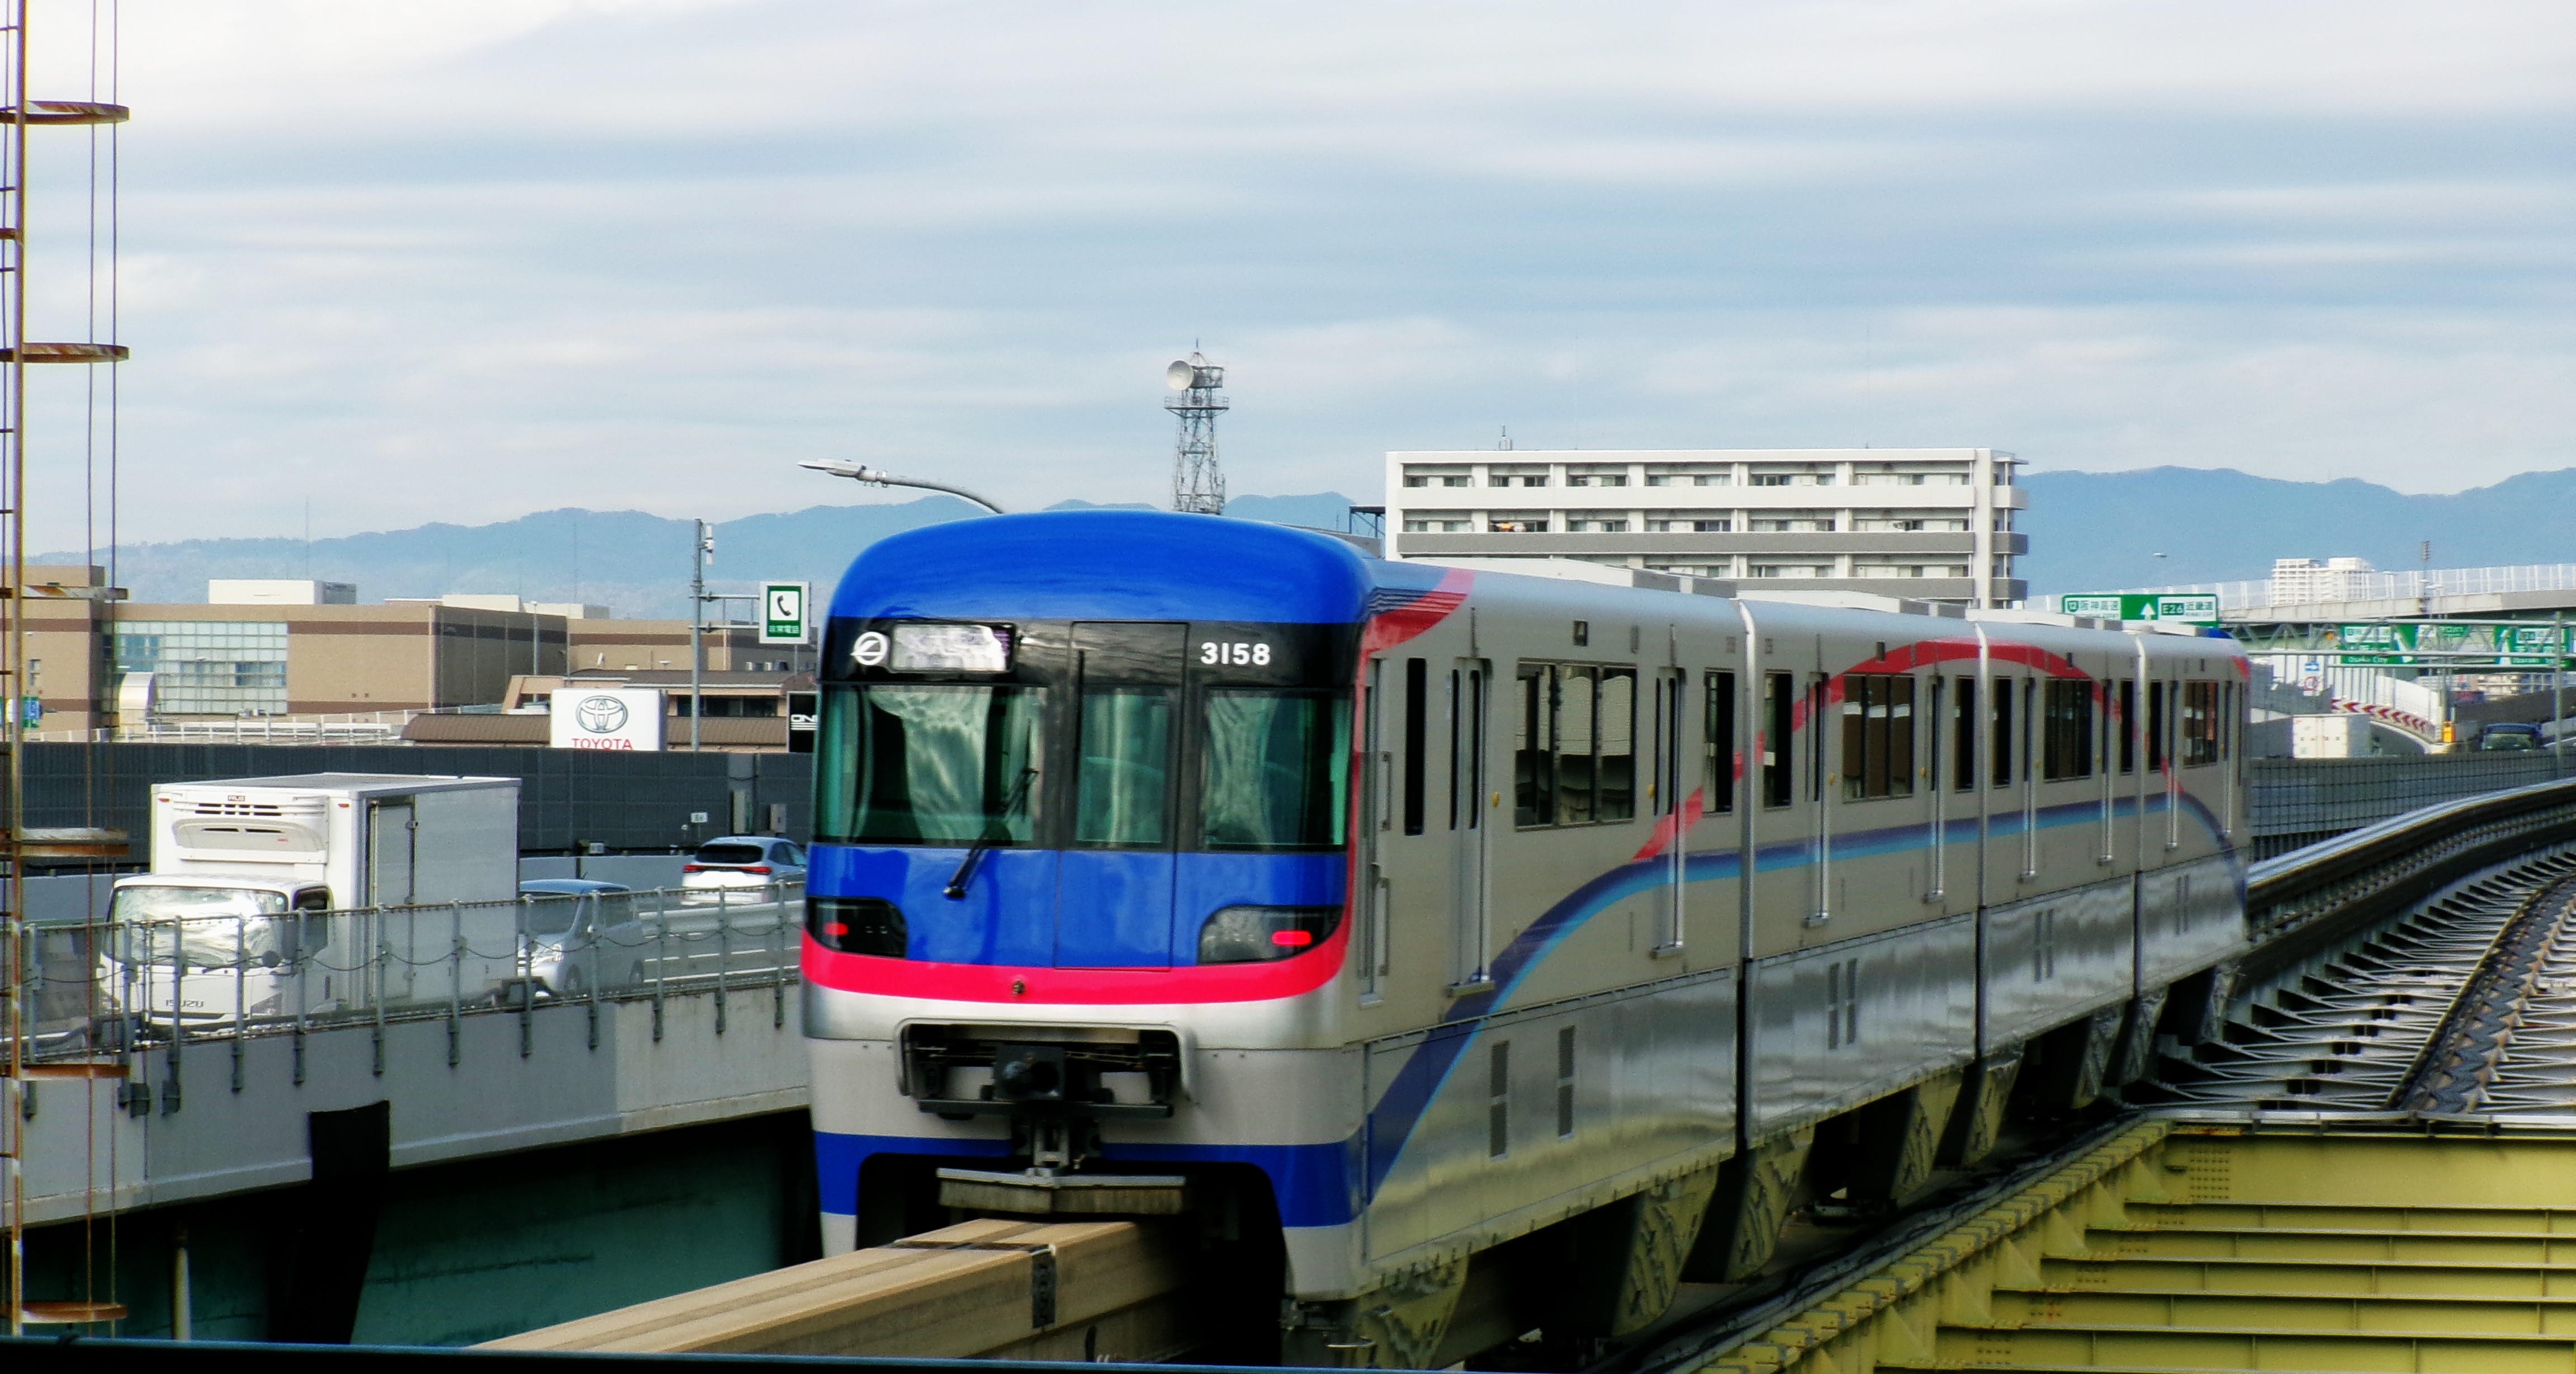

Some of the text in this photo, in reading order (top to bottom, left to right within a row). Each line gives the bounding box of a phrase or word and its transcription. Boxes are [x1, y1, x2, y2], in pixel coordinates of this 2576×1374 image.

[2162, 605, 2183, 613] E26
[1200, 642, 1271, 665] 3158
[571, 738, 633, 750] TOYOTA
